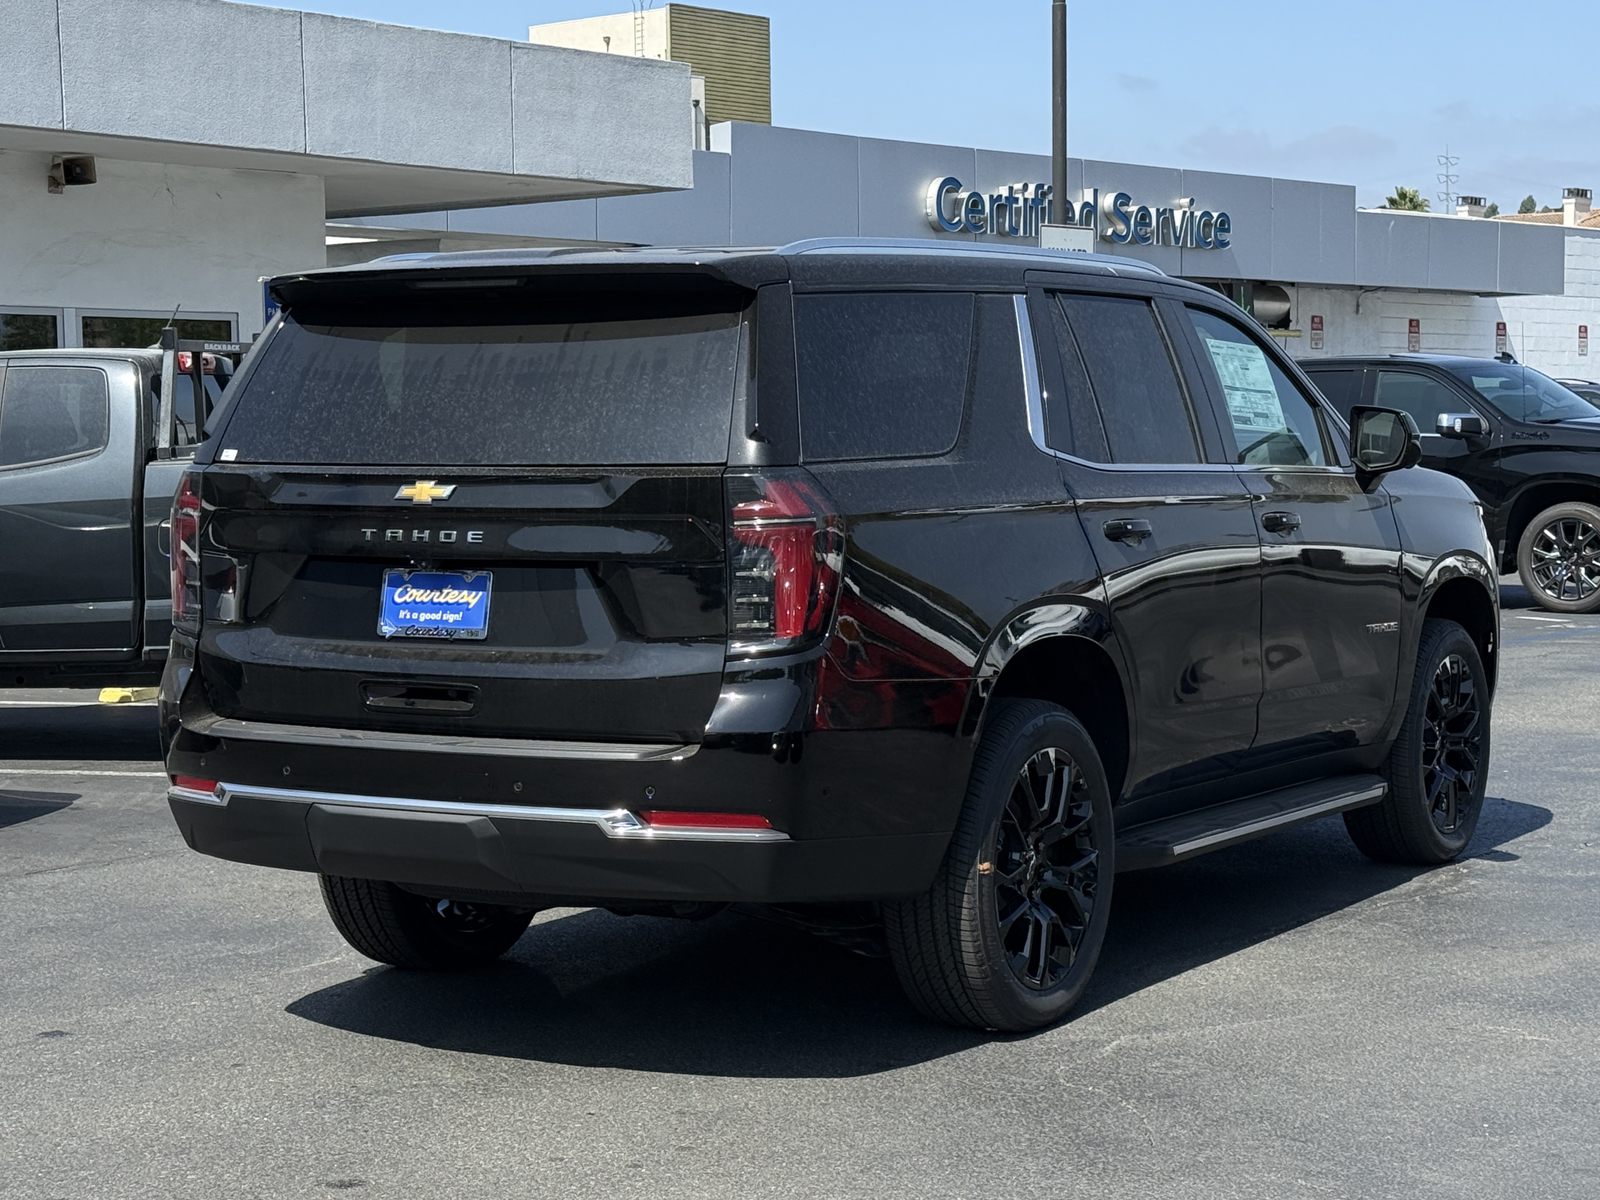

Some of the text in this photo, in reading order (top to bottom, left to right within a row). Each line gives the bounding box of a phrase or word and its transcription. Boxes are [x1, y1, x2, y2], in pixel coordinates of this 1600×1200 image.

[1104, 191, 1232, 249] Service
[204, 343, 240, 351] BACKRACK
[361, 528, 484, 543] TAHOE
[393, 584, 483, 609] Courtesy
[398, 609, 463, 623] It's a good sign!
[405, 624, 457, 639] Courtesy
